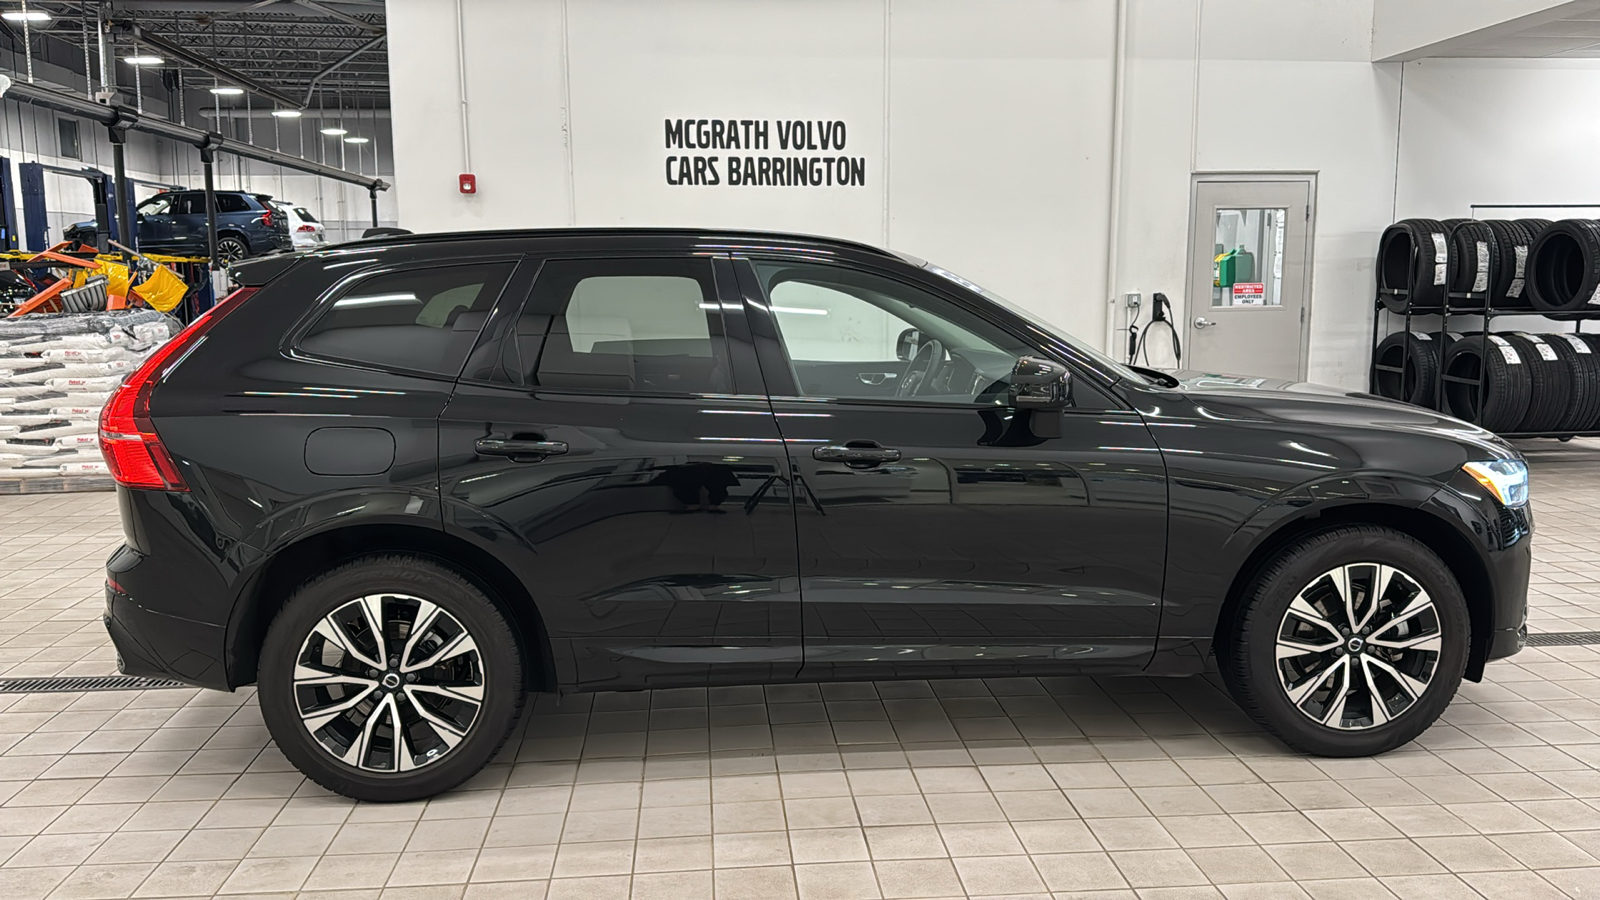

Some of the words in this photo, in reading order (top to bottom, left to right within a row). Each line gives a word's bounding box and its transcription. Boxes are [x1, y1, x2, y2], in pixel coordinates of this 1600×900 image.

[664, 119, 769, 149] MCGRATH
[776, 120, 847, 150] VOLVO
[666, 156, 720, 186] CARS
[727, 156, 866, 186] BARRINGTON
